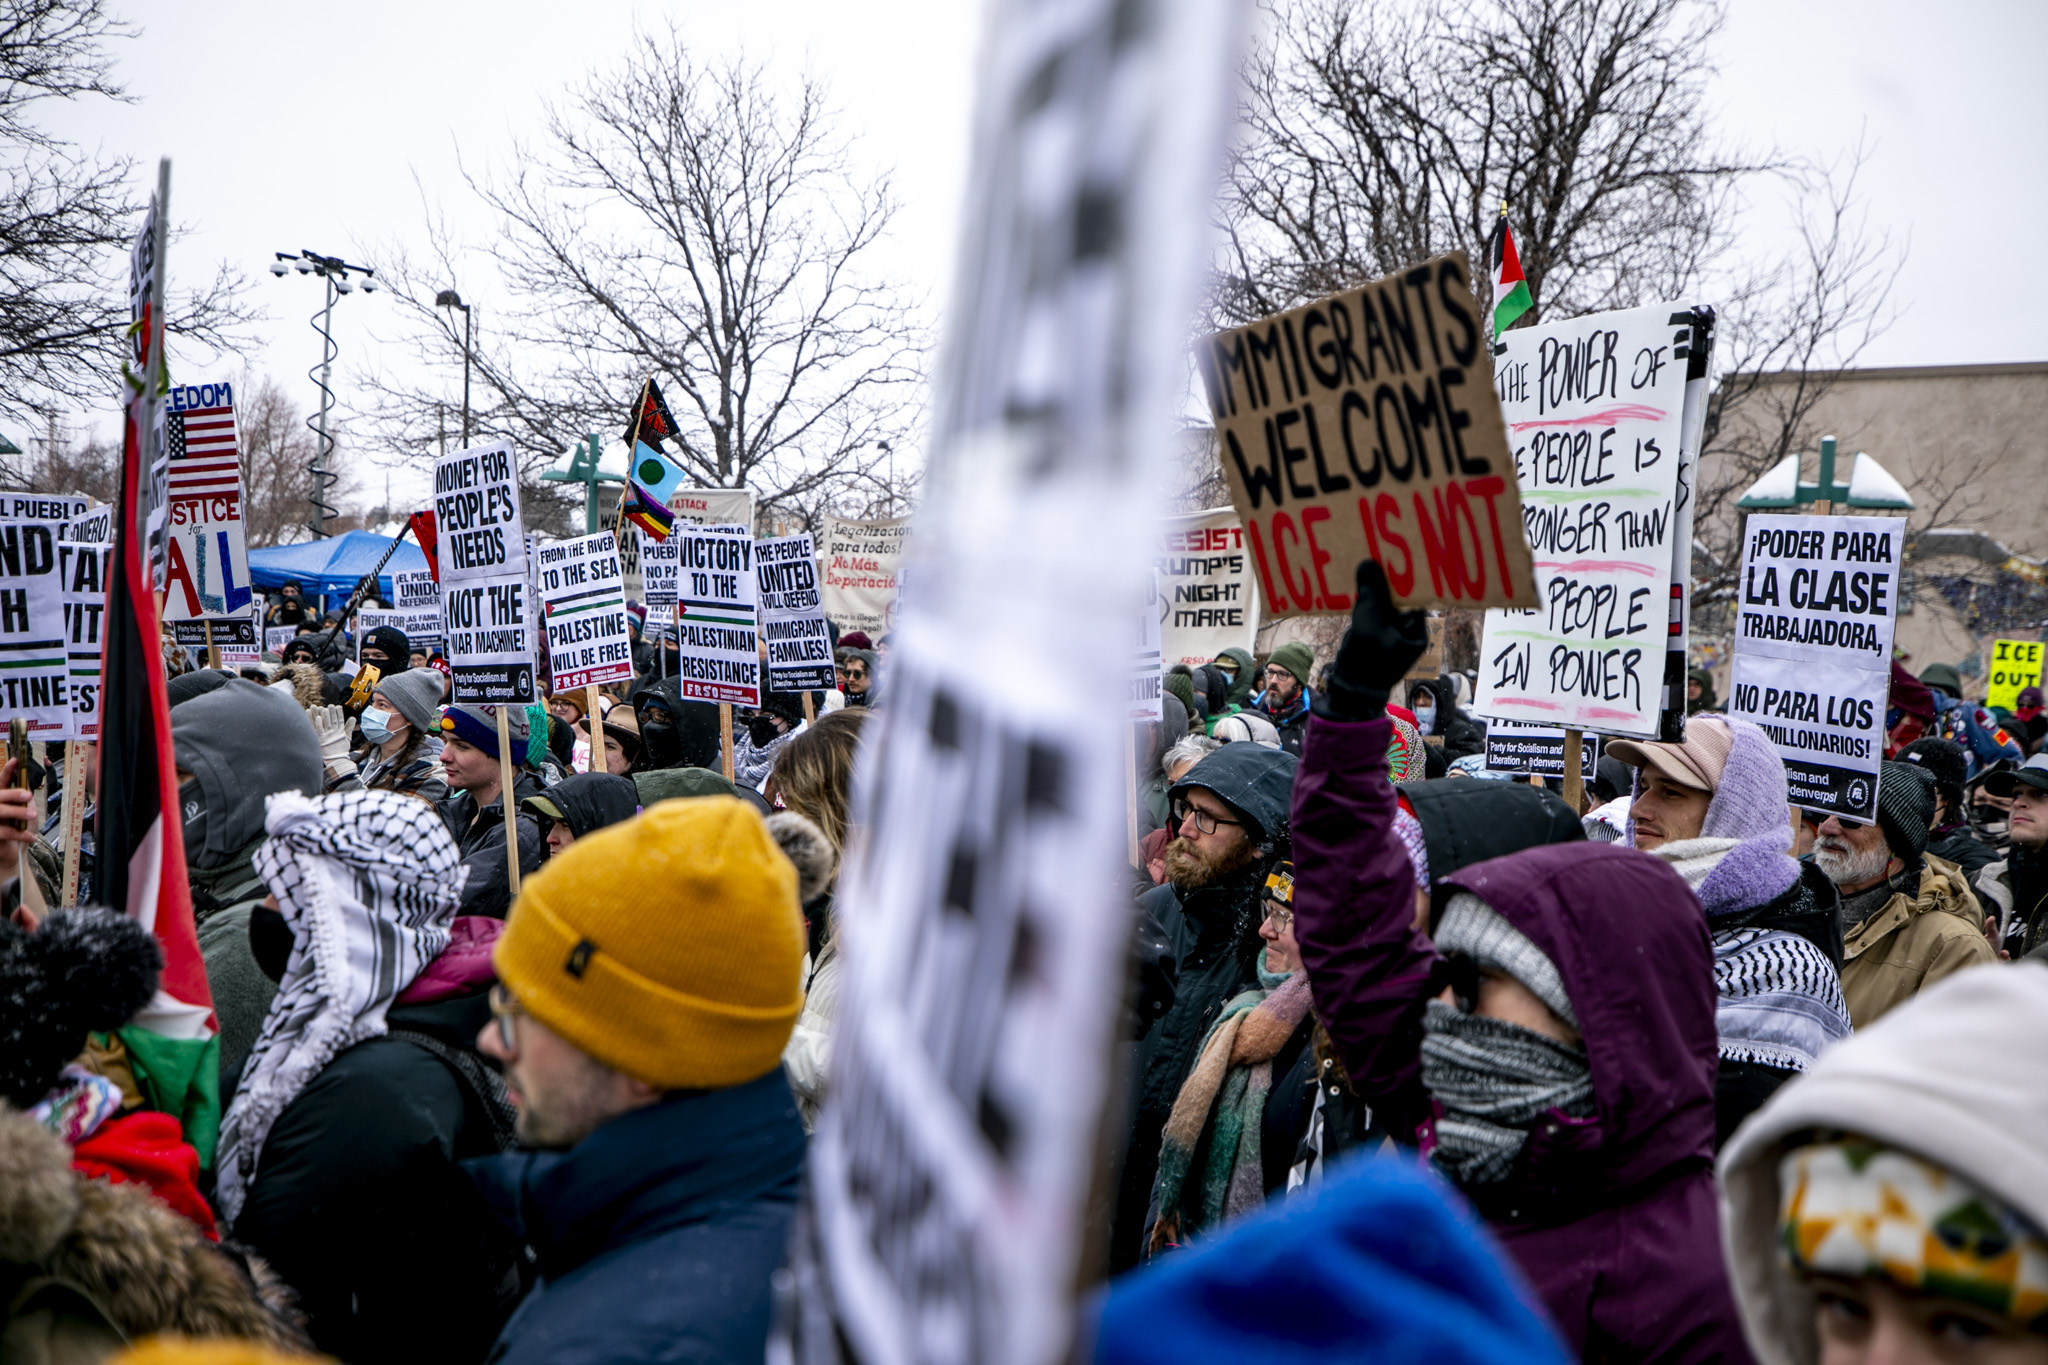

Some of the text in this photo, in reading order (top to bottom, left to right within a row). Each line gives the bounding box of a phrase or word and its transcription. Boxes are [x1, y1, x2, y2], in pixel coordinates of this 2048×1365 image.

[1200, 260, 1479, 418] IMMIGRANTS
[1495, 330, 1668, 414] THE POWER OF
[165, 382, 232, 411] EEDOM
[1226, 367, 1491, 509] WELCOME
[1532, 427, 1661, 488] PEOPLE IS
[435, 450, 510, 494] MONEY FOR
[13, 500, 87, 519] PUEBLO
[169, 498, 241, 526] STICE
[437, 484, 515, 533] PEOPLE'S
[674, 499, 707, 511] ATTACK
[188, 523, 202, 536] for
[1161, 528, 1243, 551] ESIST
[1359, 492, 1416, 598] IS
[1414, 476, 1514, 601] NOT
[1523, 500, 1671, 555] RONGER THAN
[450, 527, 506, 570] NEEDS
[540, 545, 566, 565] FROM
[568, 540, 585, 559] THE
[587, 535, 615, 556] RIVER
[680, 538, 751, 572] VICTORY
[755, 539, 811, 563] THE PEOPLE
[831, 540, 903, 555] para todos!
[1749, 529, 1892, 563] ¡PODER PARA
[162, 531, 252, 618] ALL
[542, 556, 619, 591] TO THE SEA
[646, 565, 662, 578] NO
[759, 560, 815, 593] UNITED
[827, 556, 879, 571] ¡No Más
[1153, 555, 1243, 576] RUMP'S
[401, 583, 439, 598] UNIDO
[647, 580, 658, 589] LA
[691, 572, 738, 599] TO THE
[826, 572, 897, 589] Deportació
[1175, 583, 1241, 603] NIGHT
[1745, 565, 1889, 616] LA CLASE
[399, 596, 440, 607] DEFENDER
[448, 583, 524, 629] NOT THE
[762, 590, 819, 610] WILL DEFEND
[1549, 576, 1650, 639] PEOPLE
[361, 614, 405, 627] FIGHT FOR
[548, 612, 626, 648] PALESTINE
[766, 619, 825, 640] IMMIGRANT
[1174, 608, 1243, 627] MARE
[212, 633, 237, 642] denverpsl
[450, 634, 474, 656] WAR
[475, 629, 526, 655] MACHINE!
[680, 624, 756, 652] PALESTINIAN
[1742, 612, 1883, 657] TRABAJADORA,
[552, 642, 629, 672] WILL BE FREE
[769, 639, 829, 662] FAMILIES!
[1996, 643, 2038, 662] ICE
[473, 673, 499, 683] Socialism
[682, 656, 757, 686] RESISTANCE
[1493, 642, 1641, 711] IN POWER
[1993, 671, 2038, 687] OUT
[1734, 682, 1874, 731] NO PARA LOS
[1489, 754, 1565, 770] Liberation @denverps
[1490, 742, 1563, 755] Party for Socialism and
[1808, 773, 1829, 786] and
[1787, 784, 1838, 804] denverpsl
